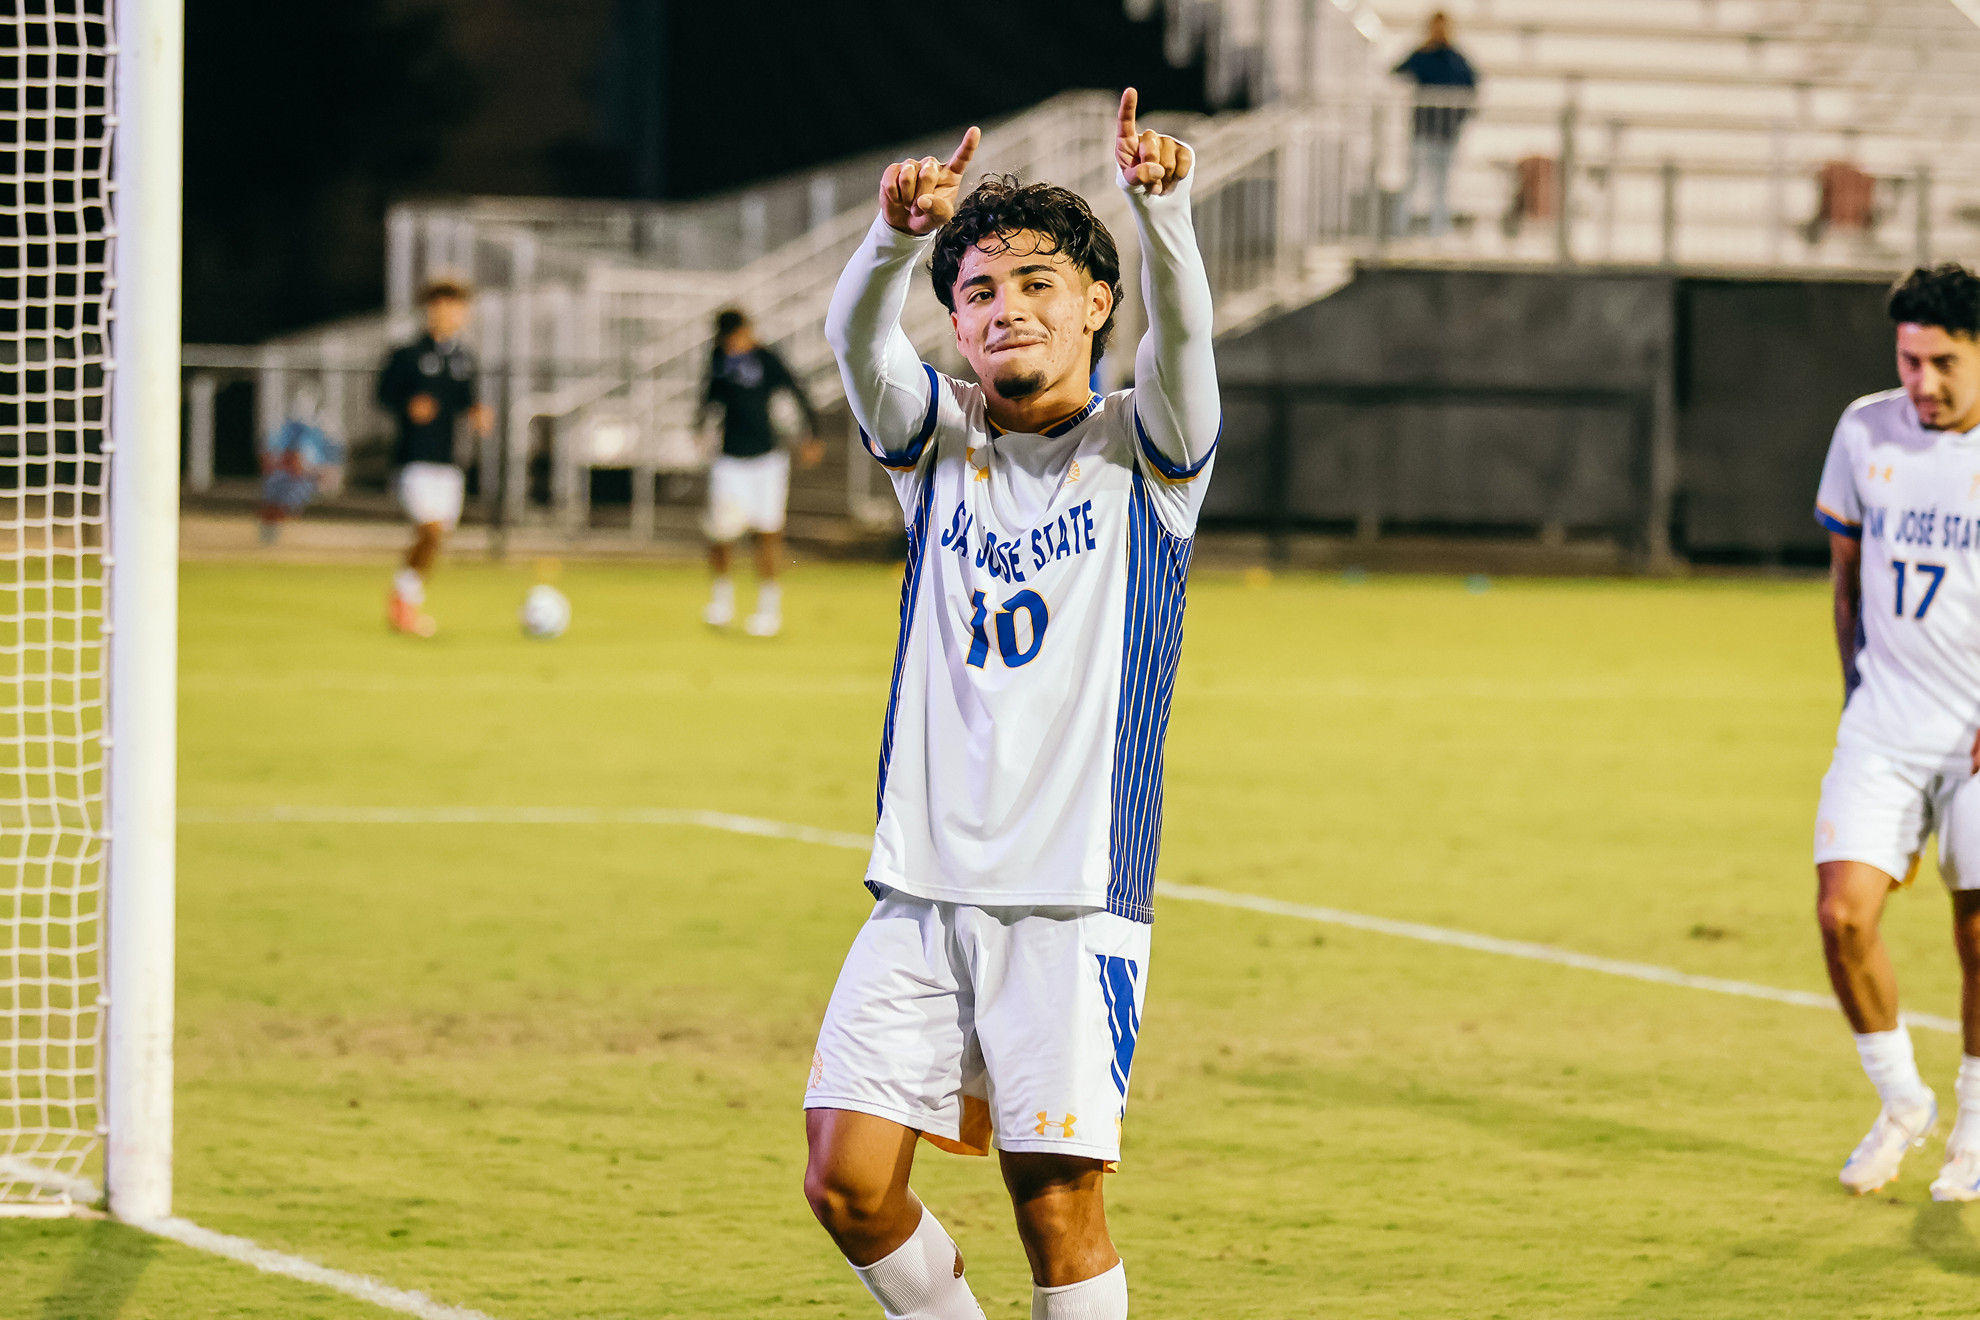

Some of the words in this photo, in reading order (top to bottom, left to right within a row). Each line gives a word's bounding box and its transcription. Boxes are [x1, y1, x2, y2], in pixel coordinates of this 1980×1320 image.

[1031, 499, 1096, 571] STATE
[1892, 560, 1946, 619] 17
[965, 587, 1051, 671] 10
